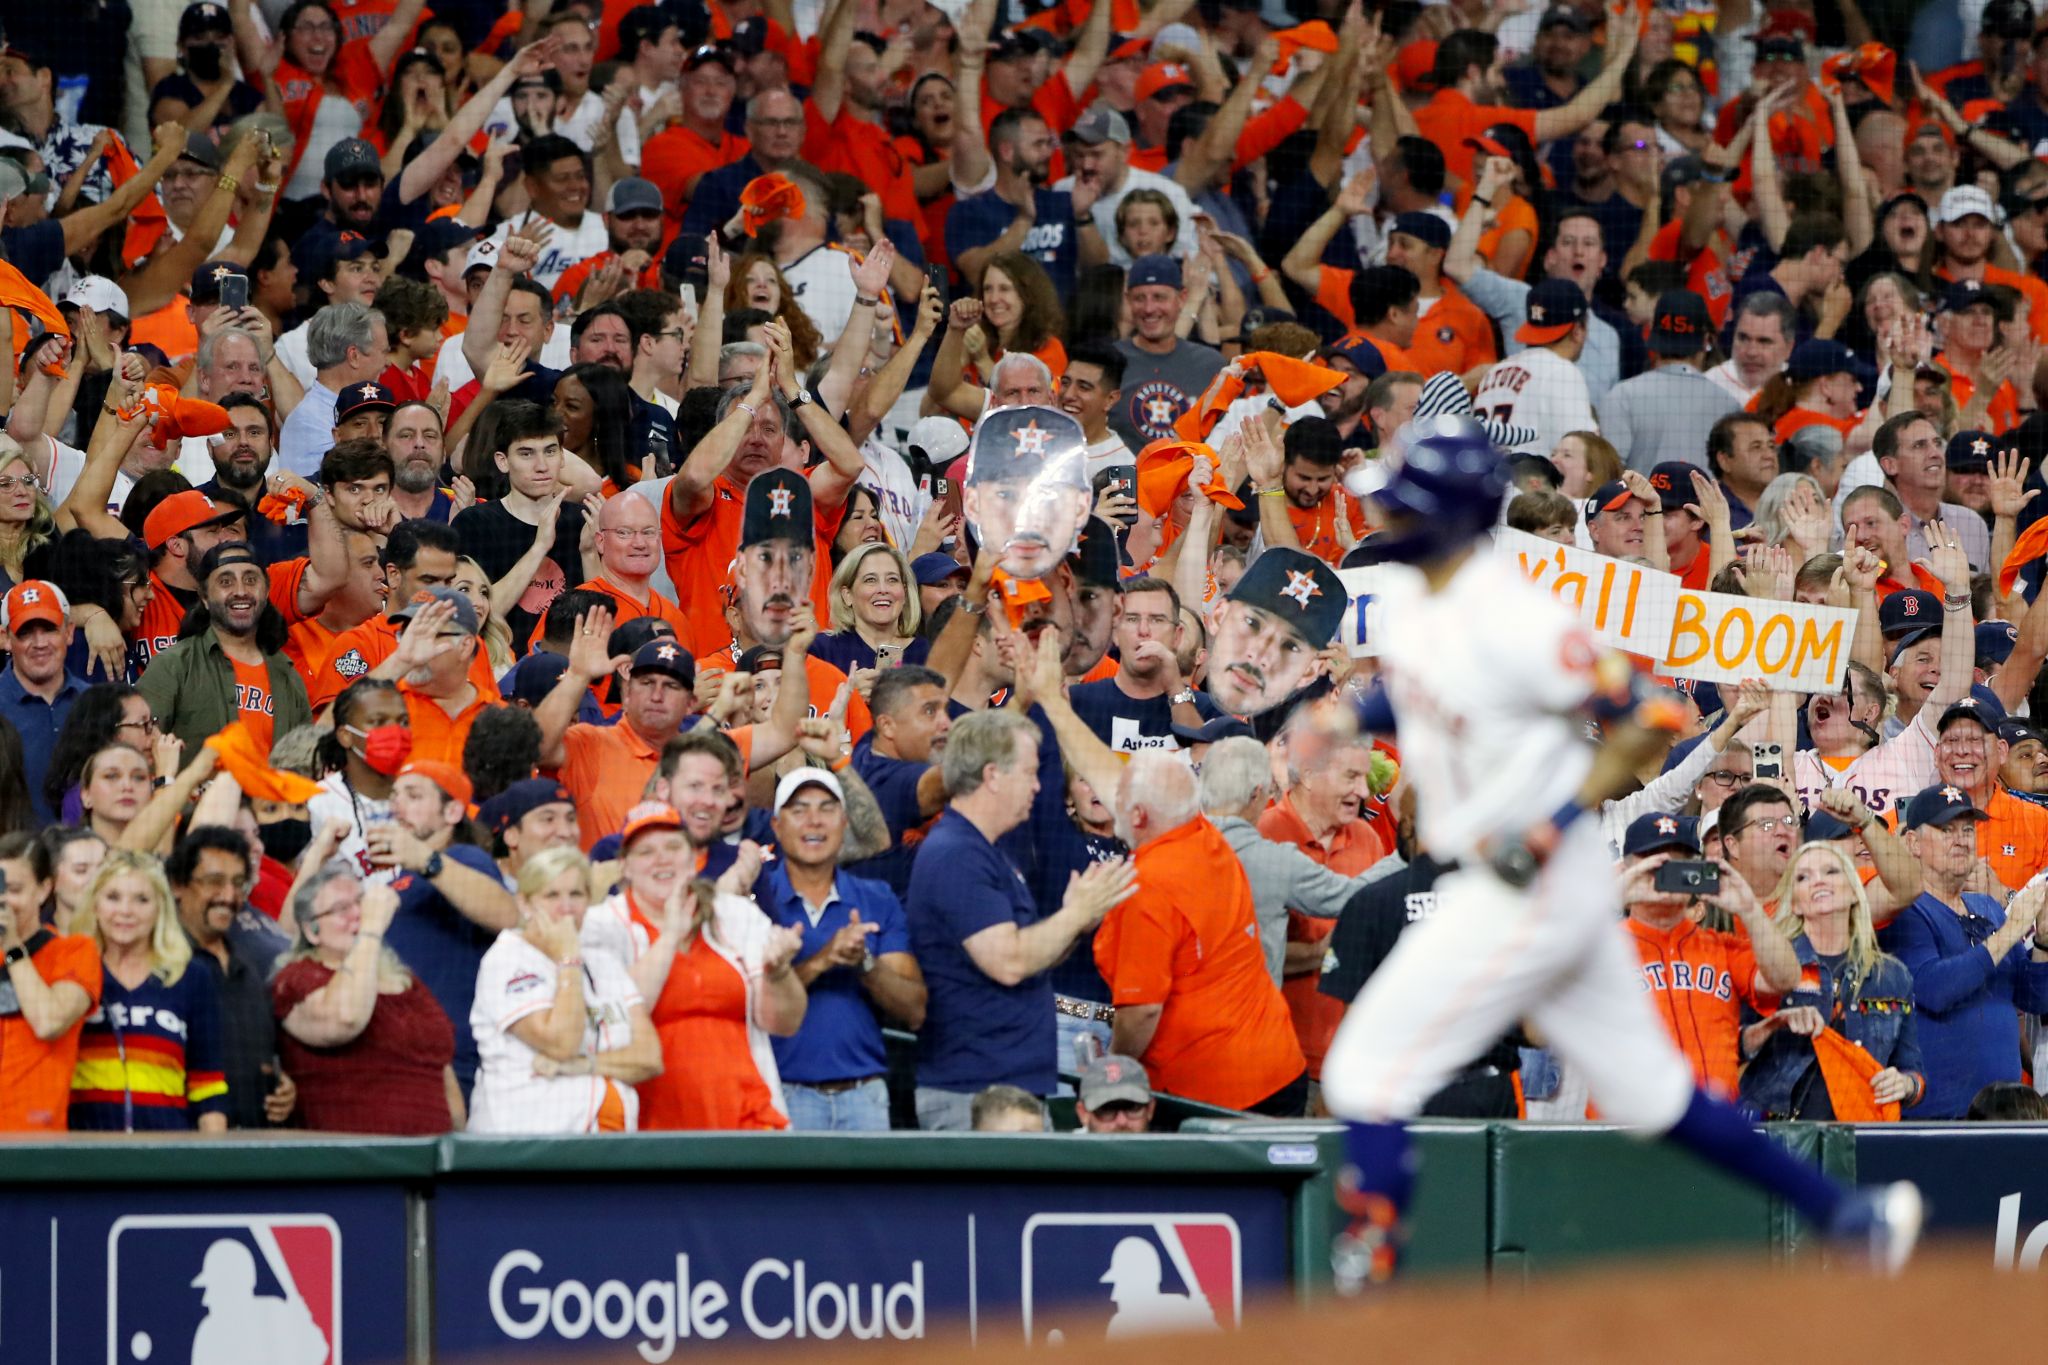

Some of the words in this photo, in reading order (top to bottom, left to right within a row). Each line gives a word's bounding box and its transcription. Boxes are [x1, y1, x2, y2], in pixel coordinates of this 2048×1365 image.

[1478, 366, 1532, 394] LTUVE
[1662, 593, 1845, 685] BOOM
[335, 658, 369, 670] WORLD
[1121, 737, 1166, 751] Astros
[489, 1248, 731, 1364] Google
[740, 1257, 926, 1341] Cloud
